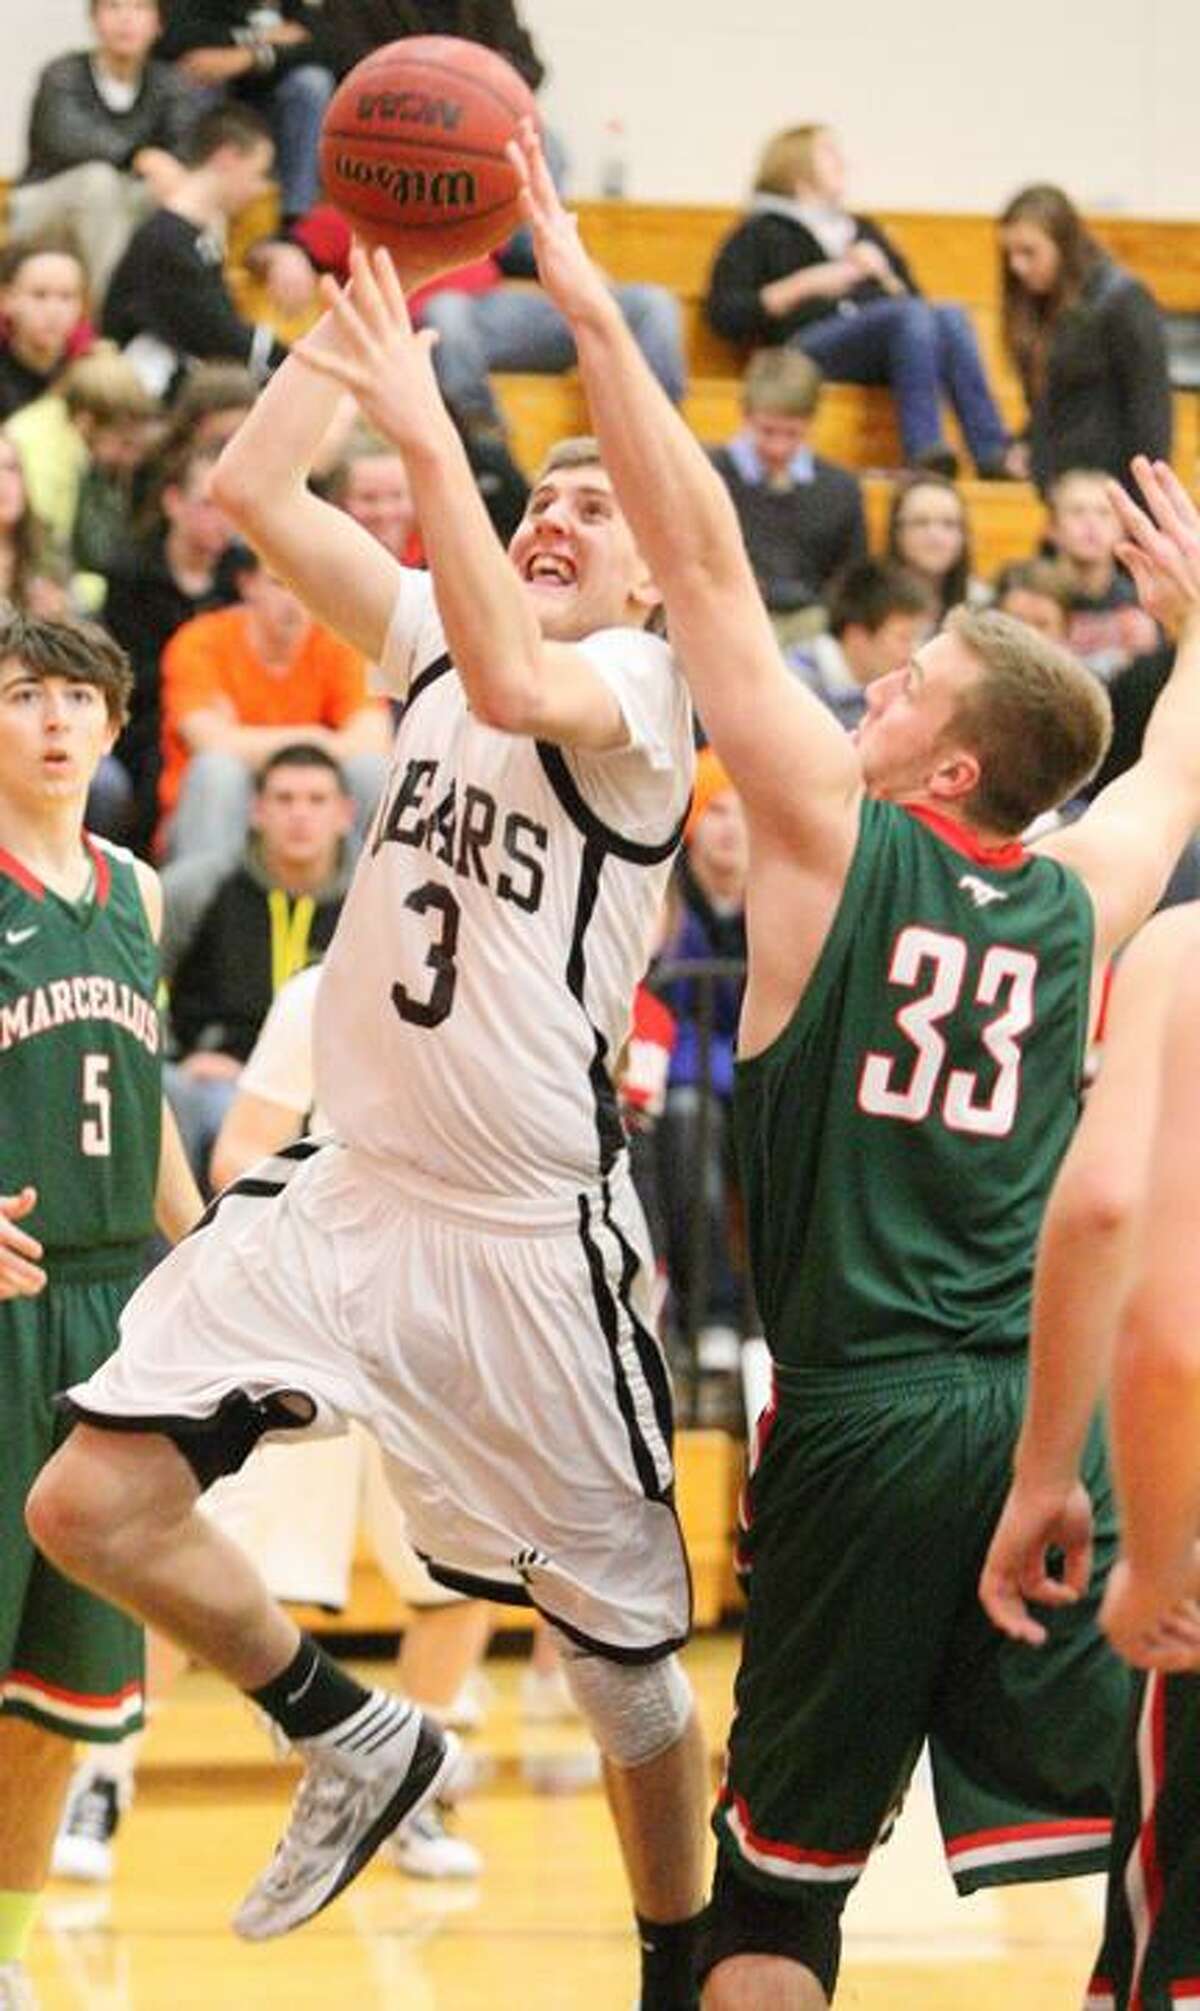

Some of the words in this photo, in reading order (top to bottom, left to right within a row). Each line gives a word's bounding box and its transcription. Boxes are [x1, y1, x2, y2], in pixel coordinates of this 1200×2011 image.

[336, 153, 476, 207] Wilson
[371, 759, 548, 914] EARS
[0, 975, 160, 1055] MARCELLUS
[391, 881, 460, 1029] 3
[857, 924, 1038, 1139] 33
[81, 1053, 112, 1157] 5
